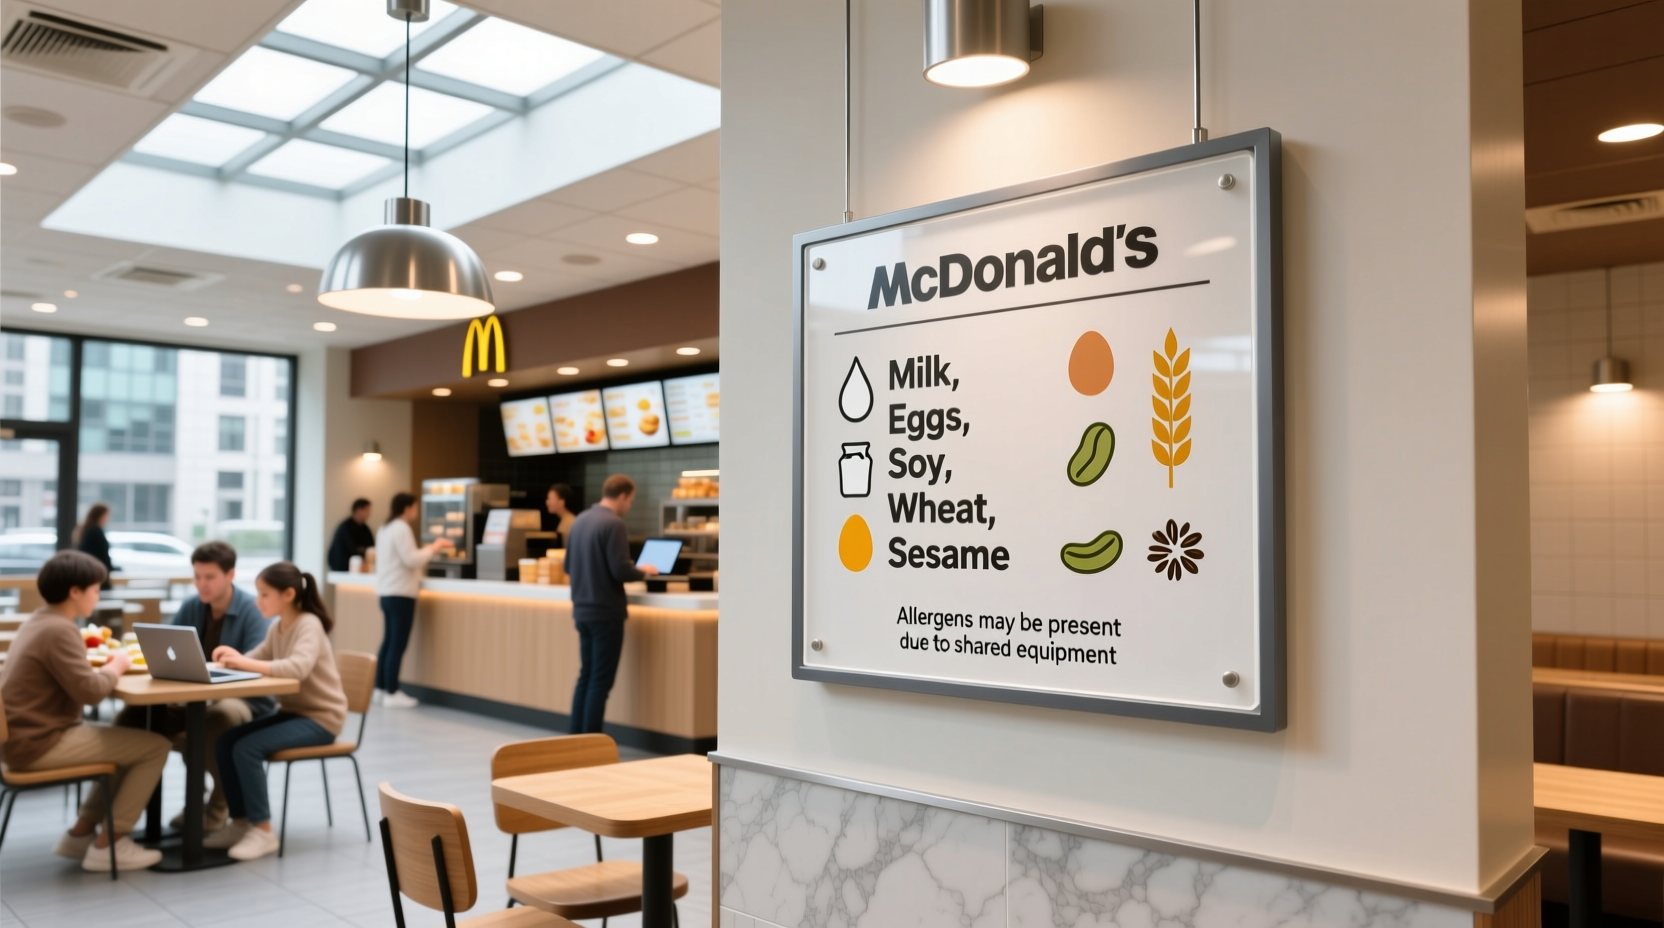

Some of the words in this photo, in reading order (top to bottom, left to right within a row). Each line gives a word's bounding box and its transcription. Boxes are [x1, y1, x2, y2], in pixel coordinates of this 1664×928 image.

[867, 224, 1159, 310] McDonald's
[462, 315, 506, 378] M
[888, 354, 960, 392] Milk,
[888, 403, 971, 442] Eggs,
[887, 447, 953, 486] Soy,
[887, 492, 997, 531] Wheat,
[887, 536, 1011, 571] Sesame
[896, 605, 975, 630] Allergens
[978, 613, 1016, 636] may
[1020, 611, 1043, 633] be
[1048, 616, 1123, 638] present
[899, 631, 929, 651] due
[932, 634, 951, 653] to
[954, 634, 1011, 658] shared
[1016, 642, 1118, 666] equipment
